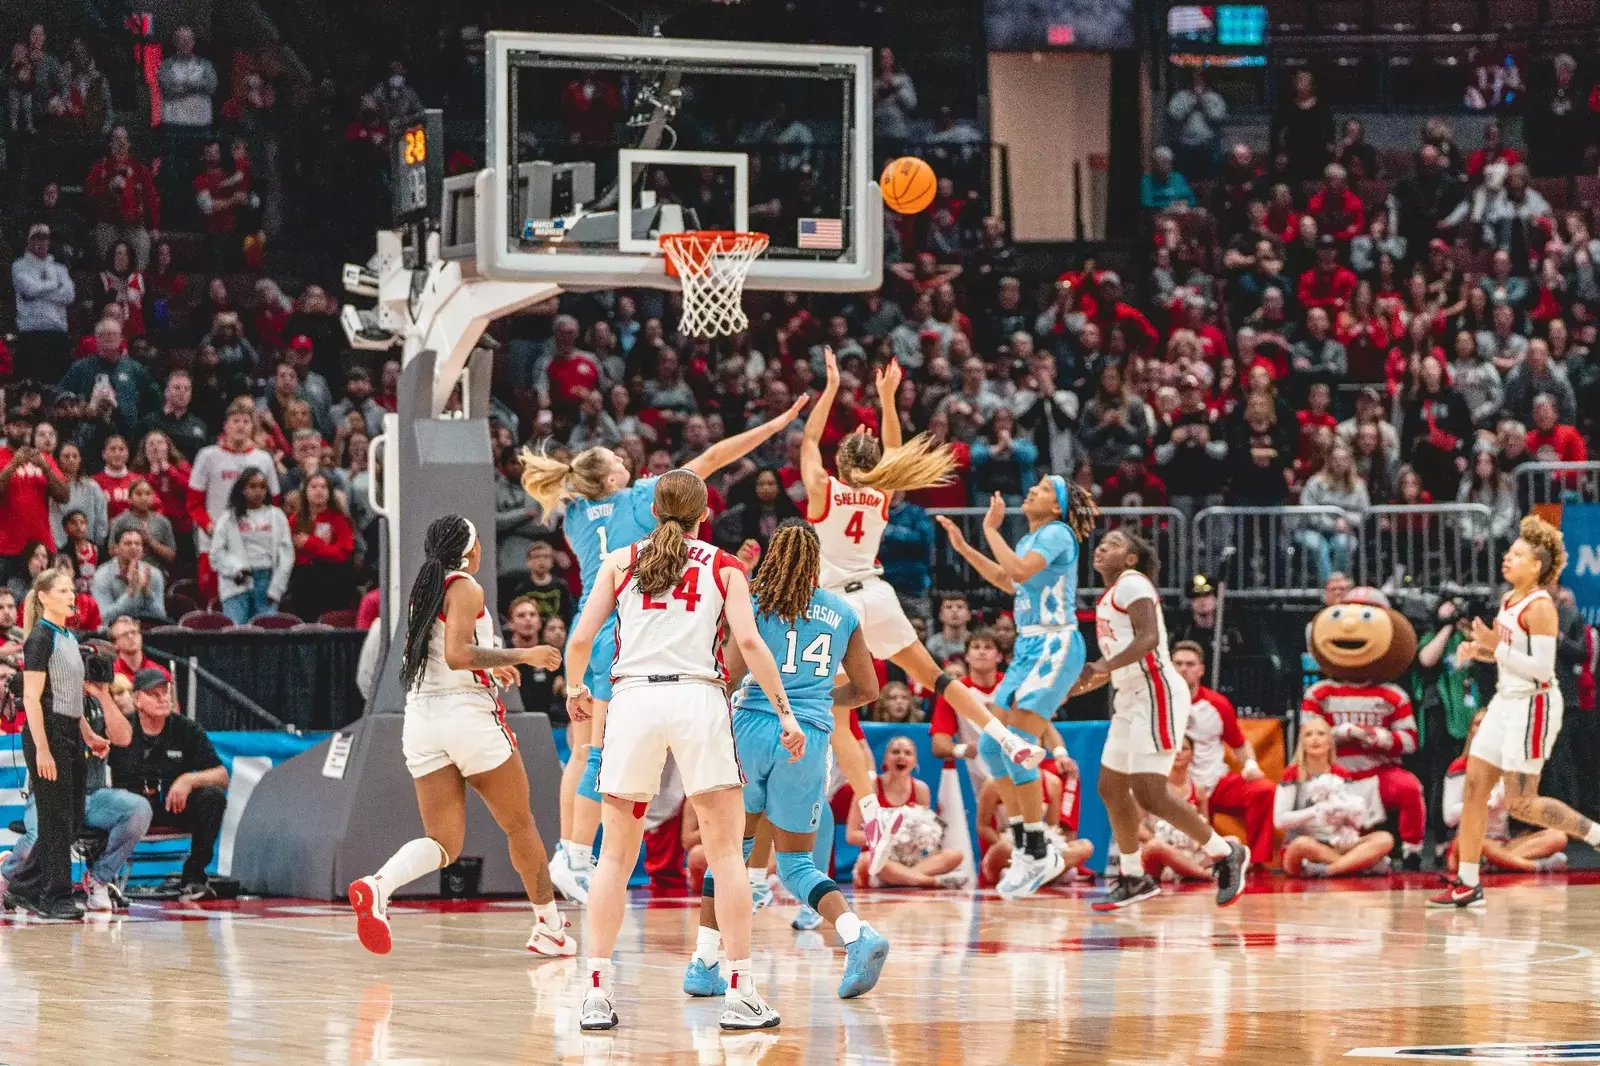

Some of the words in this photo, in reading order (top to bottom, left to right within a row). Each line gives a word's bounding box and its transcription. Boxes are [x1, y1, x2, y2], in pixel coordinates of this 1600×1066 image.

[834, 492, 882, 507] SHELDON
[596, 525, 608, 561] 1
[844, 510, 865, 544] 4
[781, 630, 832, 677] 14
